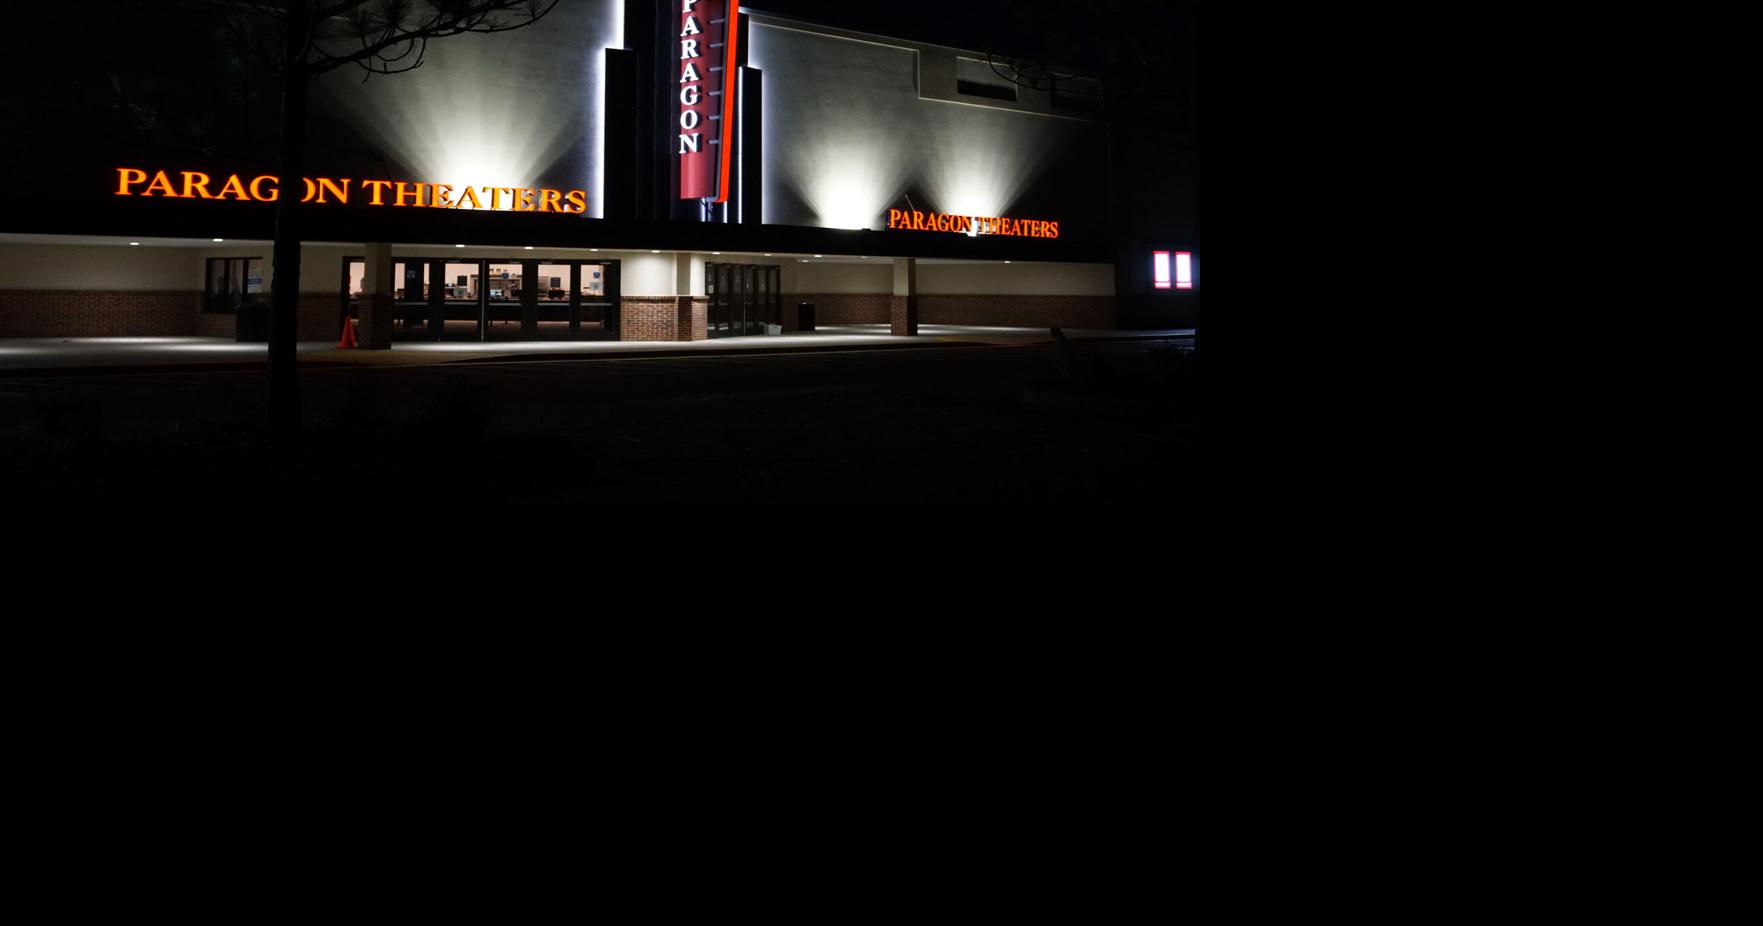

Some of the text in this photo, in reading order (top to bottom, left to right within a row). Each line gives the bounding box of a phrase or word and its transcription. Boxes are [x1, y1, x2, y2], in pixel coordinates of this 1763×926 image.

[679, 0, 700, 154] PARAGON
[362, 179, 587, 214] THEATERS
[888, 208, 1059, 238] PARAGON THEATERS
